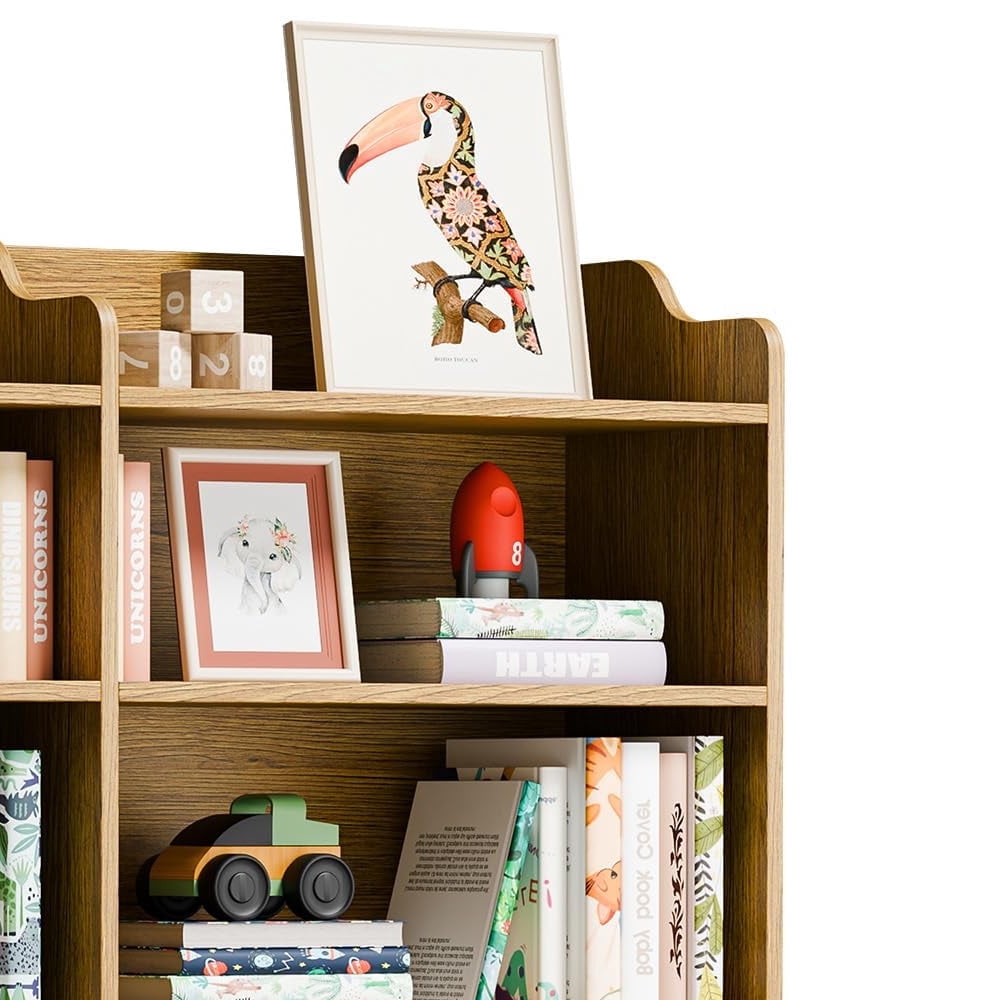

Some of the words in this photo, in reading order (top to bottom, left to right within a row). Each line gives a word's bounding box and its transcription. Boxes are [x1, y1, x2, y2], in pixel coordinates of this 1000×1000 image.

[201, 290, 233, 315] 3
[169, 346, 182, 381] 8
[200, 353, 230, 377] 2
[248, 354, 267, 378] 8
[2, 500, 21, 632] DINOSAURS
[33, 489, 48, 644] UNICORNS
[512, 541, 522, 566] 8
[130, 491, 145, 644] UNICORNS
[496, 651, 610, 678] EARTH
